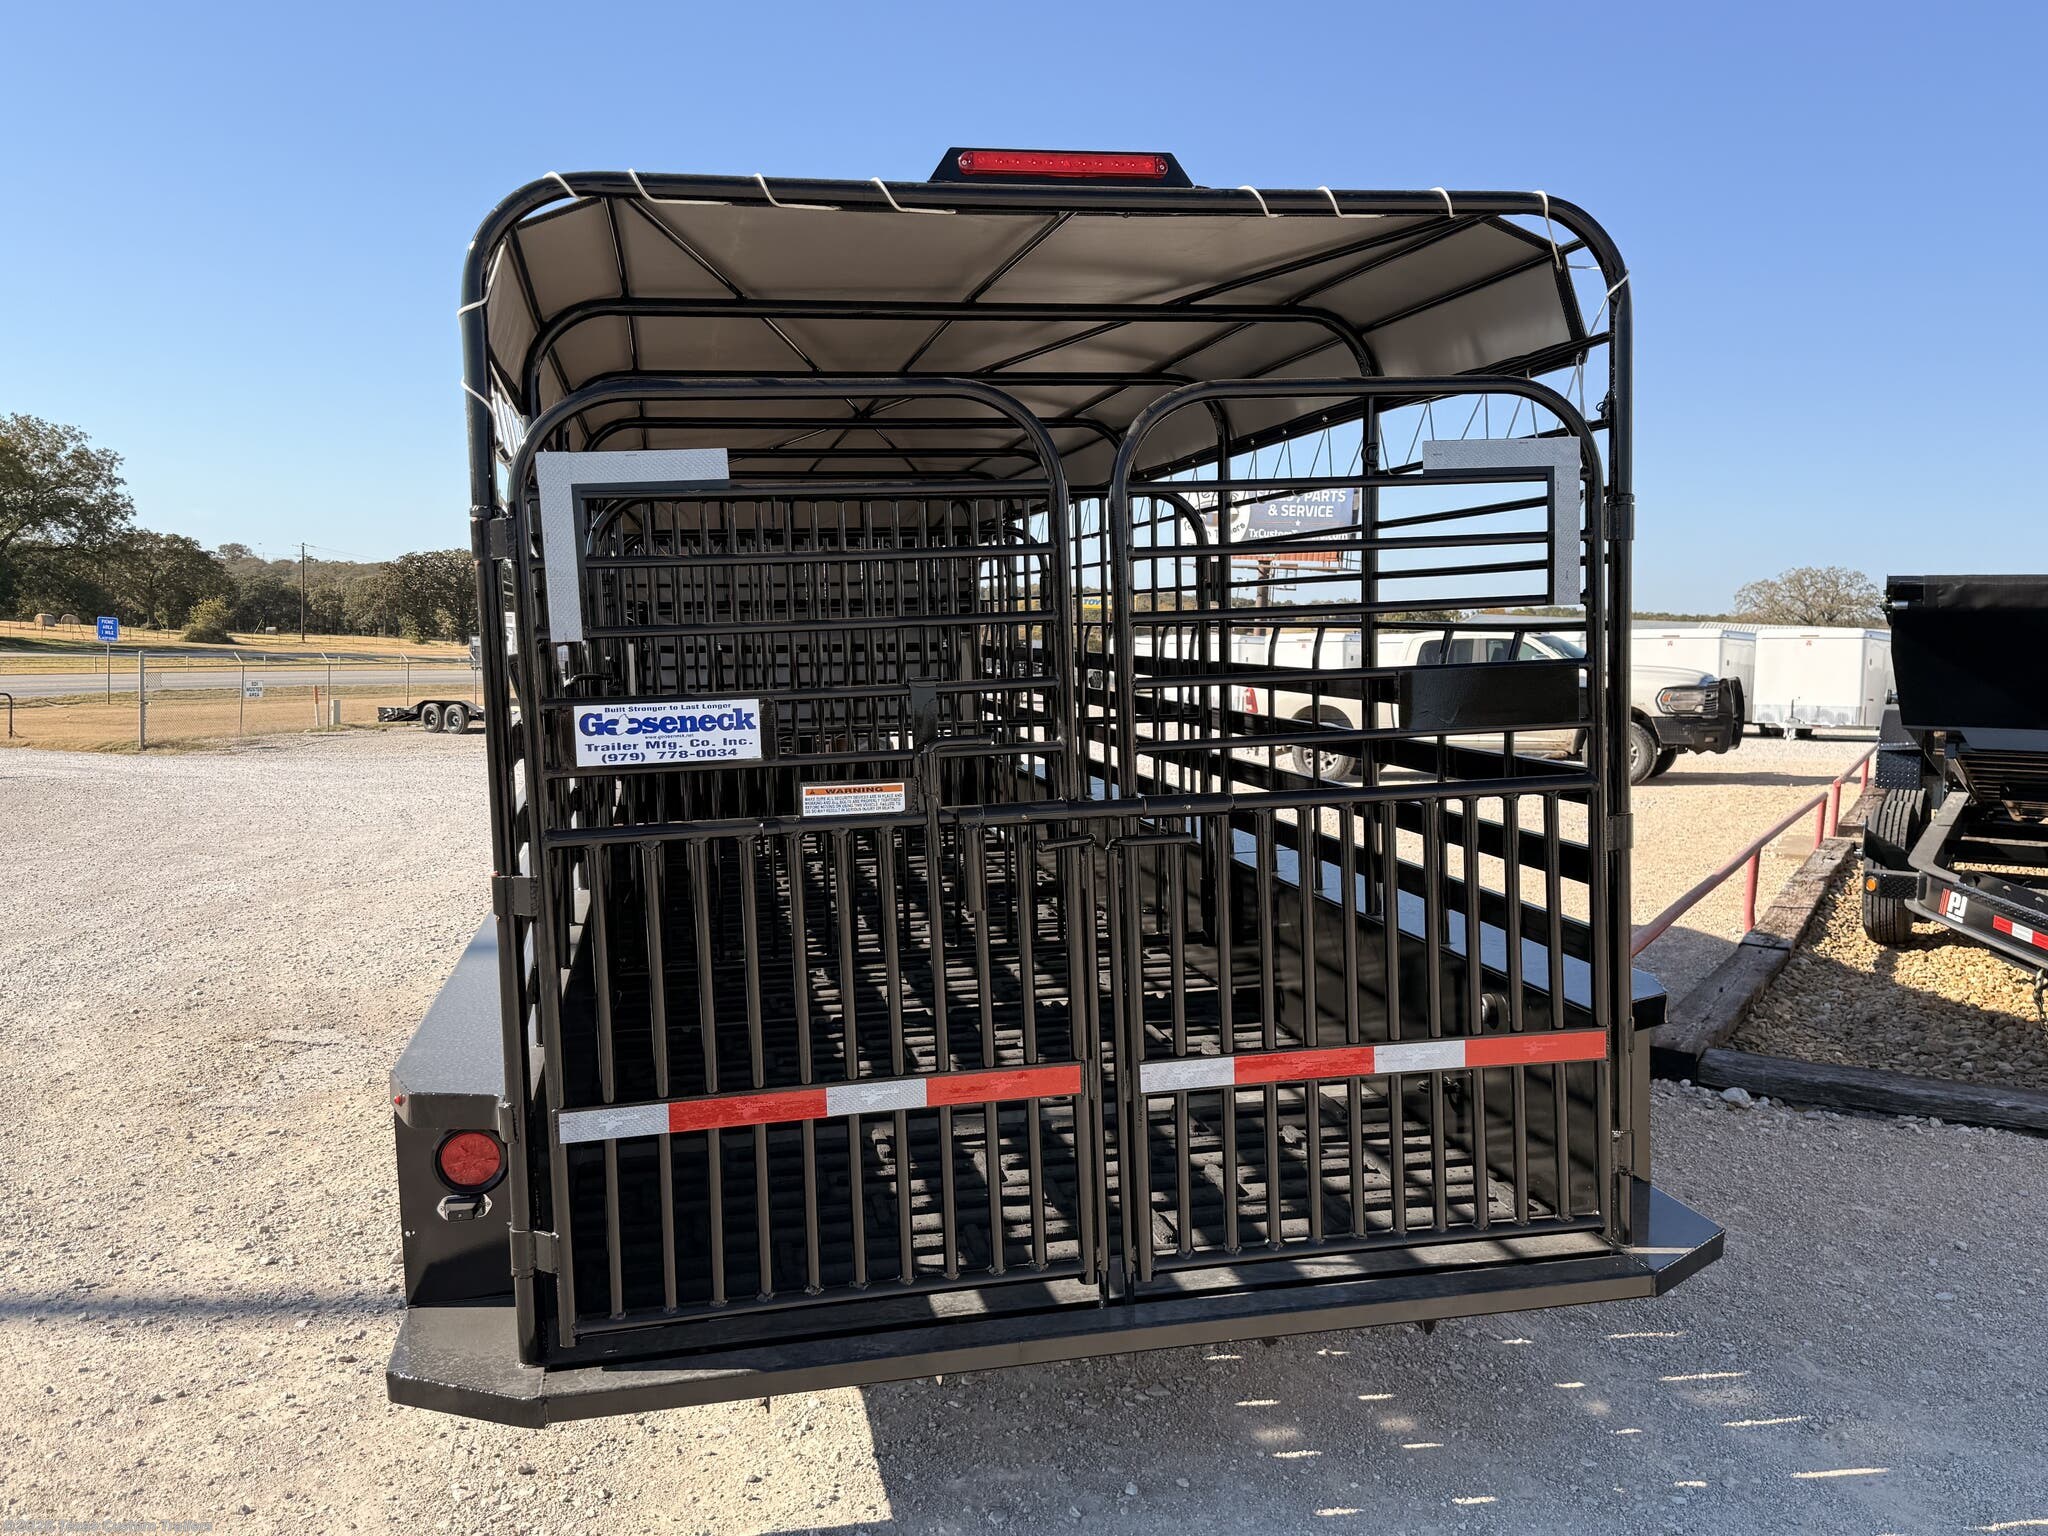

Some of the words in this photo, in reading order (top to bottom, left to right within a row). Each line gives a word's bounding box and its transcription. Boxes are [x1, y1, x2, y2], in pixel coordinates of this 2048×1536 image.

[1305, 490, 1346, 503] PARTS
[1268, 504, 1278, 516] &
[1281, 504, 1334, 517] SERVICE
[579, 708, 756, 736] Gooseneck
[585, 742, 639, 752] Trailer
[645, 740, 683, 750] Mfg.
[690, 739, 715, 748] Co.
[722, 737, 753, 746] Inc.
[601, 752, 645, 764] (979)
[657, 748, 737, 760] 778-0034
[826, 786, 883, 794] WARNING
[1947, 891, 1968, 917] PJ
